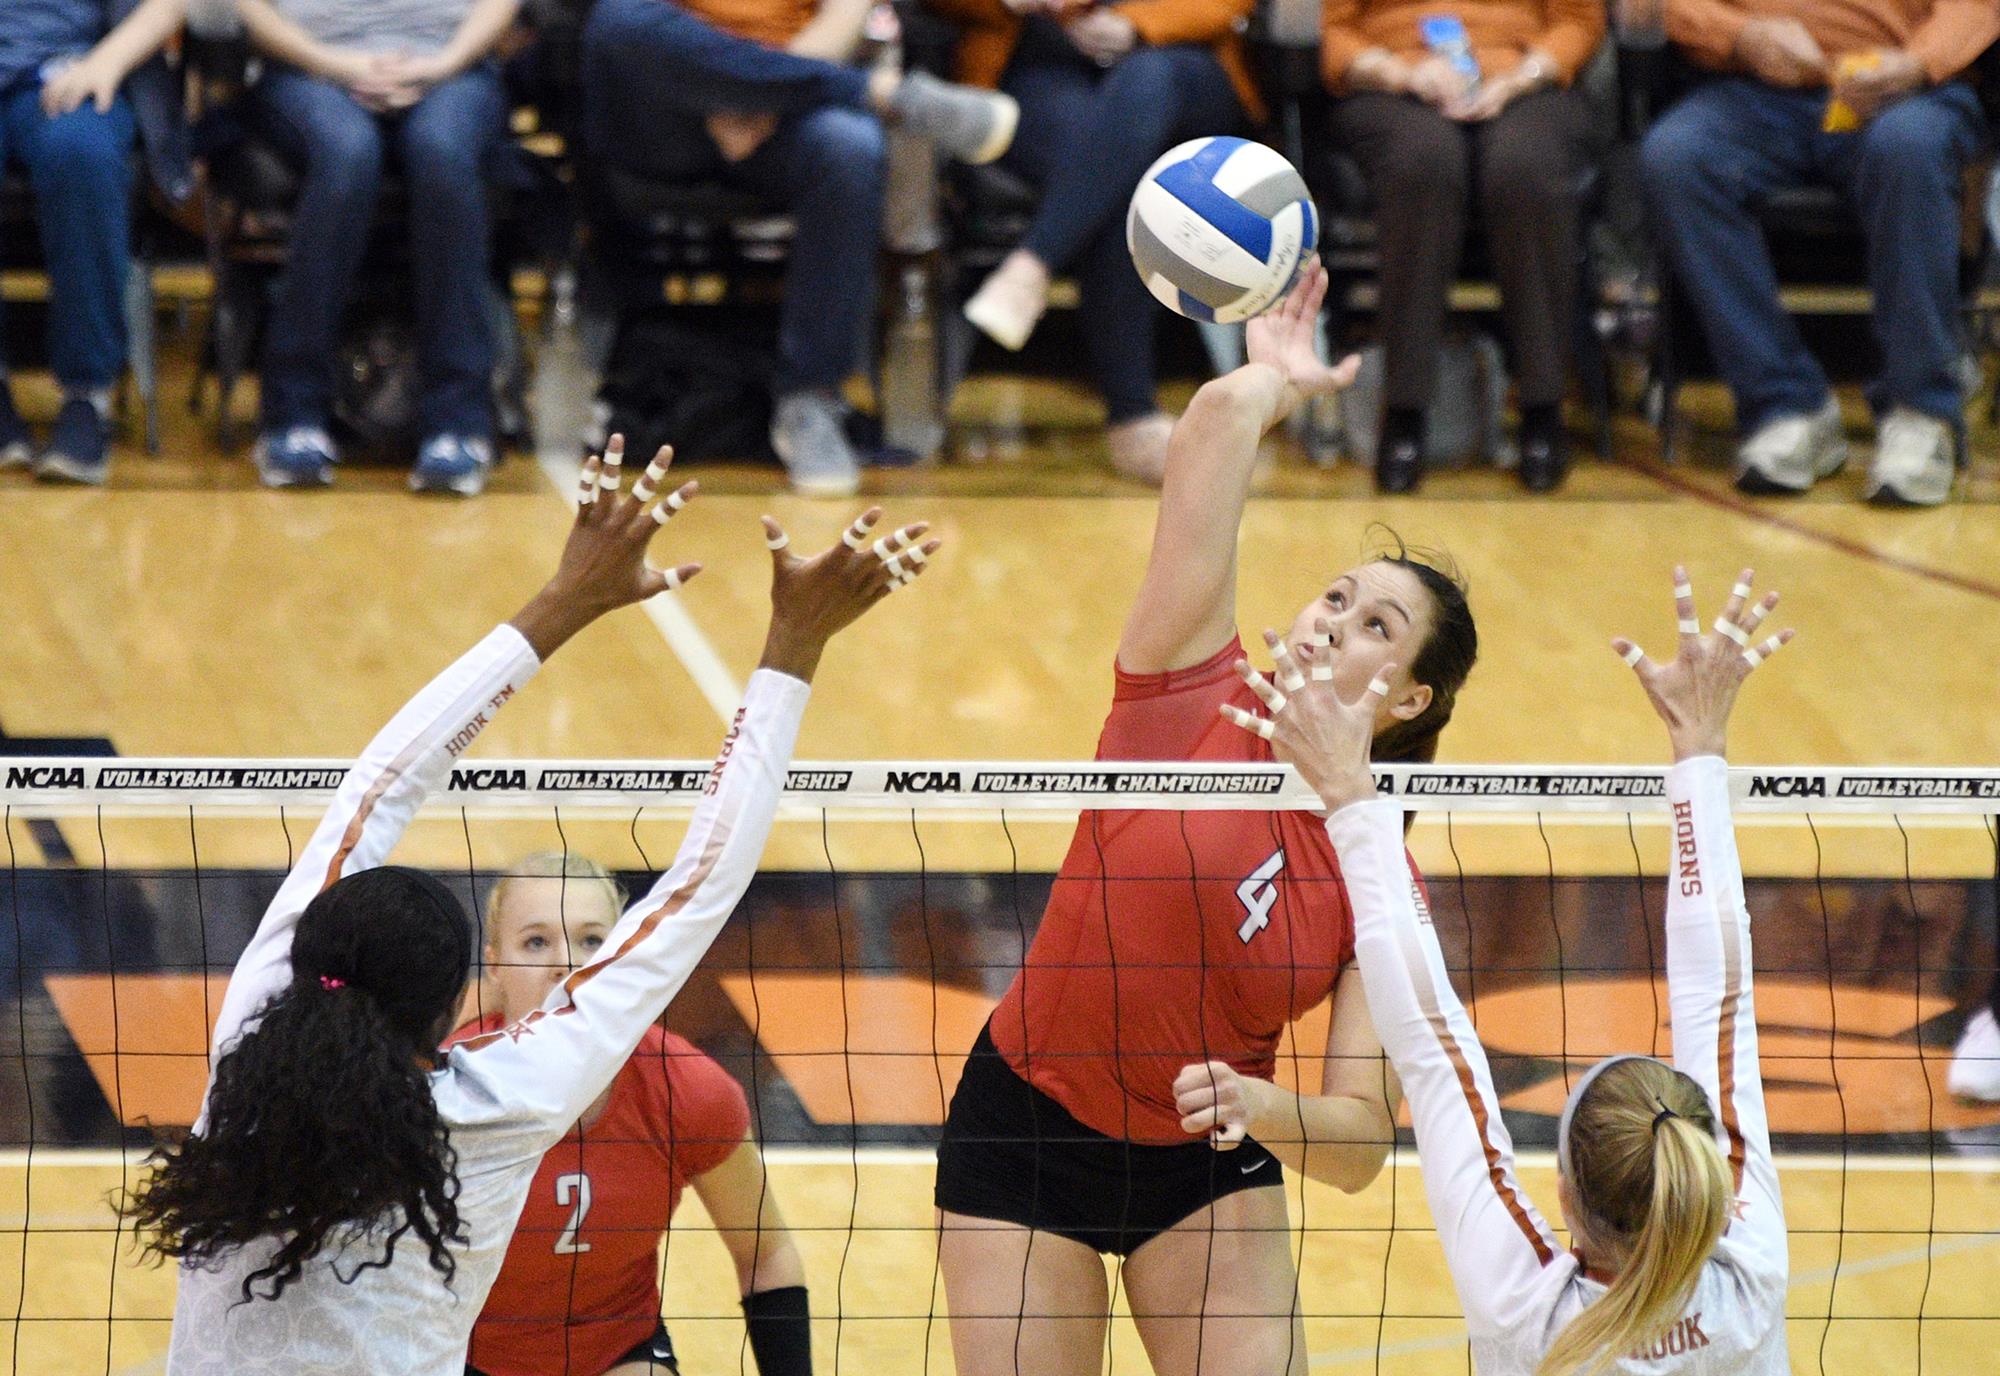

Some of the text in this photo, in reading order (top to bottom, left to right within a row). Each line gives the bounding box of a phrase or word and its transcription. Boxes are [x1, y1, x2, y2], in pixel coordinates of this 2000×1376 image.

[444, 711, 489, 758] HOOK
[5, 767, 85, 789] NCAA
[101, 771, 236, 789] VOLLEYBALL
[240, 771, 348, 788] CHAMPIO
[448, 769, 527, 791] NCAA
[543, 772, 675, 790] VOLLEYBALL
[884, 771, 961, 793] NCAA
[978, 774, 1109, 792] VOLLEYBALL
[1114, 775, 1281, 792] CHAMPIONSHIP
[1411, 777, 1541, 794] VOLLEYBALL
[1749, 776, 1827, 798] NCAA
[1842, 779, 1973, 797] VOLLEYBALL
[1673, 799, 1703, 898] HORNS
[1234, 846, 1285, 945] 4
[553, 1171, 593, 1255] 2
[1630, 1312, 1710, 1360] OOK
